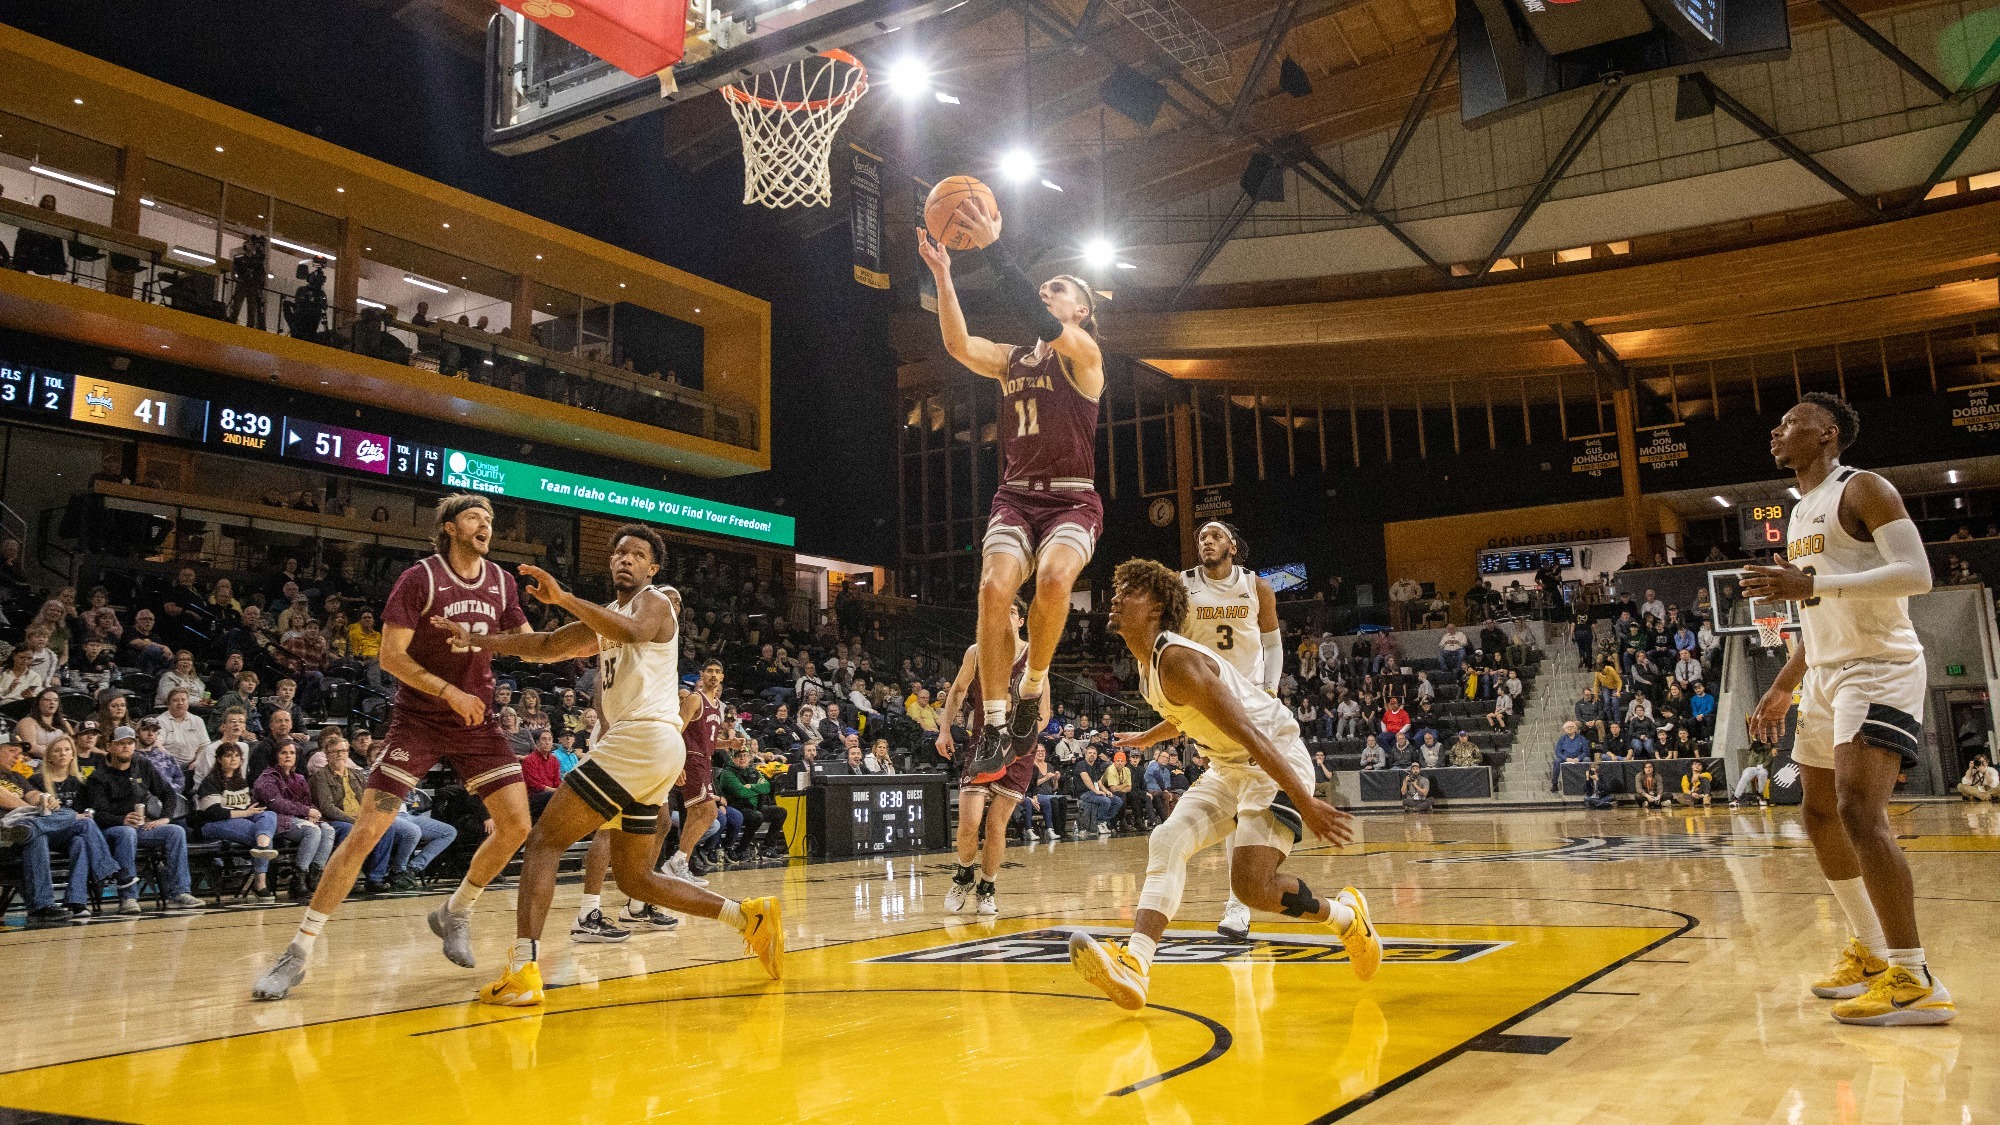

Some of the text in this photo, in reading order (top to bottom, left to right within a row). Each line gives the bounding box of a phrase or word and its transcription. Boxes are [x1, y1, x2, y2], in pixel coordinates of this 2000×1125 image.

[1, 368, 21, 381] FLS
[44, 376, 64, 390] TOL
[1, 384, 15, 401] 3
[45, 392, 59, 409] 2
[1970, 398, 1988, 407] PAT
[134, 399, 167, 426] 41
[1015, 398, 1040, 437] 11
[220, 408, 271, 436] 8:39
[1967, 422, 2000, 432] 142-39
[223, 432, 266, 448] 2ND HALF
[315, 432, 341, 457] 51
[1653, 438, 1672, 446] DON
[397, 444, 411, 455] TOL
[425, 450, 439, 461] FLS
[1586, 447, 1603, 455] GUS
[1640, 442, 1687, 455] MONSON
[398, 458, 408, 472] 3
[1573, 452, 1617, 465] JOHNSON
[426, 462, 435, 477] 5
[466, 459, 505, 482] Country
[447, 475, 505, 494] Real Estate
[541, 479, 772, 532] Team Idaho Can Help YOU Find Your Freedom!
[1196, 501, 1232, 512] SIMMONS
[1754, 506, 1782, 520] 8:38
[1488, 528, 1611, 549] CONCESSIONS
[1787, 533, 1825, 561] DAHO
[443, 600, 496, 621] MONTANA
[1197, 605, 1249, 619] IDAHO
[1216, 625, 1234, 650] 3
[853, 791, 869, 801] HOME
[880, 790, 902, 807] 8:38
[907, 790, 923, 799] GUEST
[854, 808, 868, 822] 41
[909, 805, 921, 821] 51
[886, 826, 893, 842] 2
